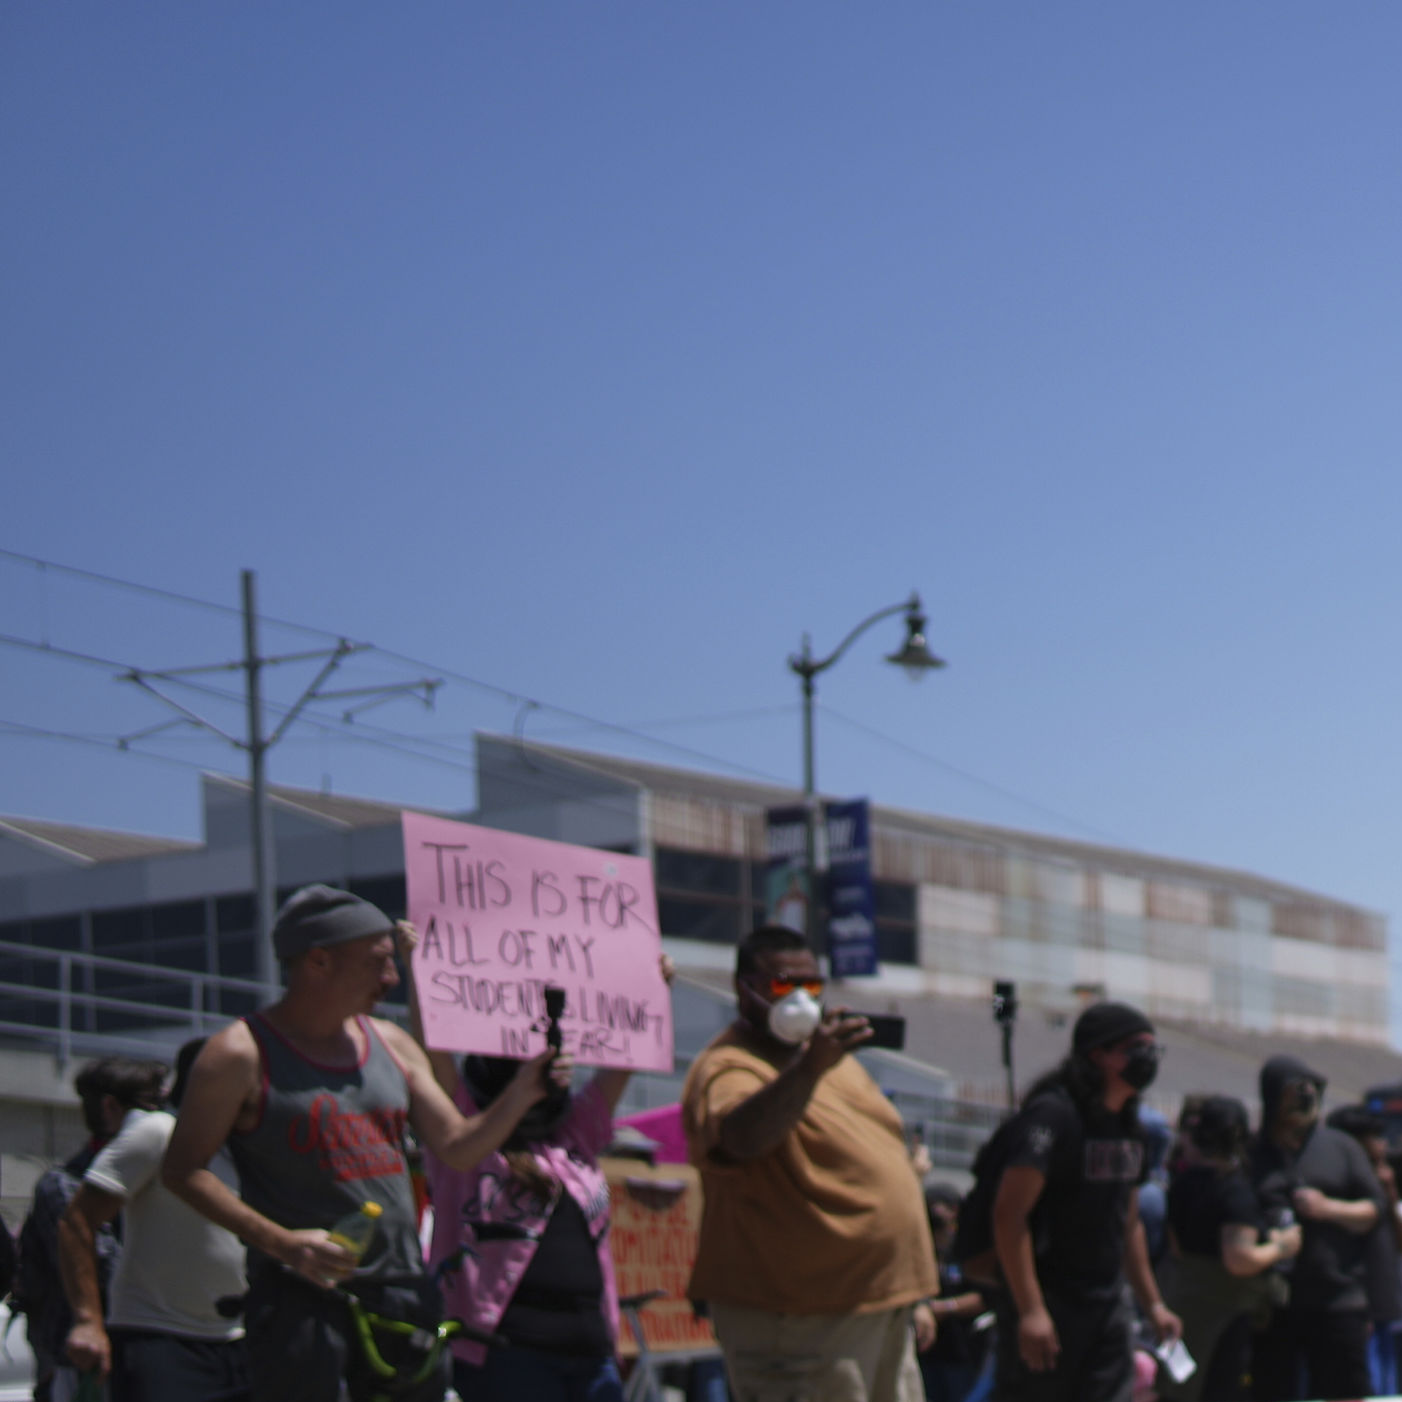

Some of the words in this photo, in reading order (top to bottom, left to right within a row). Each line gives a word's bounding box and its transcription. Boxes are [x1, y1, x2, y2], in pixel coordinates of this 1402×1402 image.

[421, 841, 512, 910] THIS
[531, 868, 567, 918] IS
[575, 875, 660, 936] FOR
[421, 914, 490, 967] ALL
[498, 929, 537, 970] OF
[549, 933, 595, 980] MY
[500, 1026, 529, 1055] IN
[562, 1025, 634, 1064] EAR!
